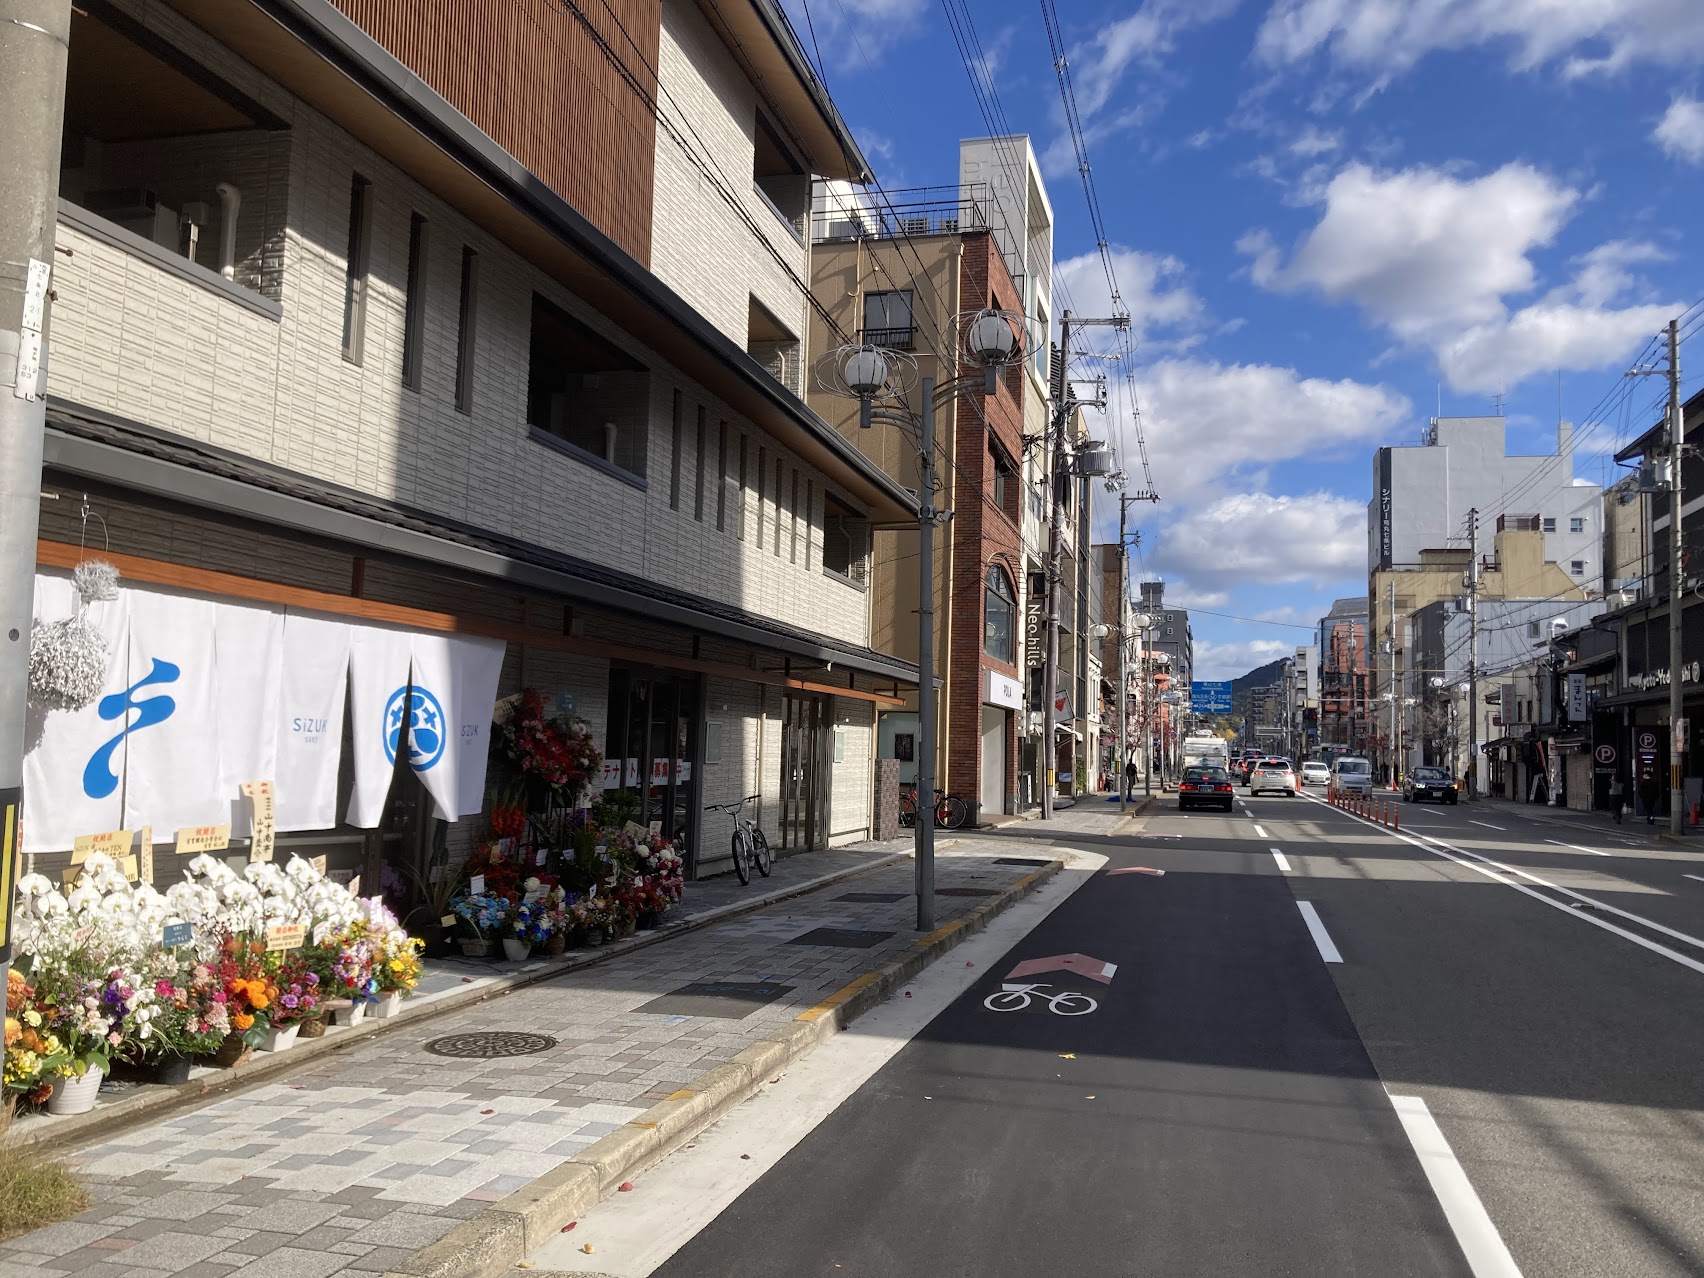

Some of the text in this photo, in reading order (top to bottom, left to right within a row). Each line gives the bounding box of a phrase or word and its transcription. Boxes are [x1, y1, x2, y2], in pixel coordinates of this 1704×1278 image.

[1027, 604, 1041, 666] Neo hills
[1003, 684, 1012, 698] POLA
[1638, 665, 1691, 691] Kyoto-Yodshi
